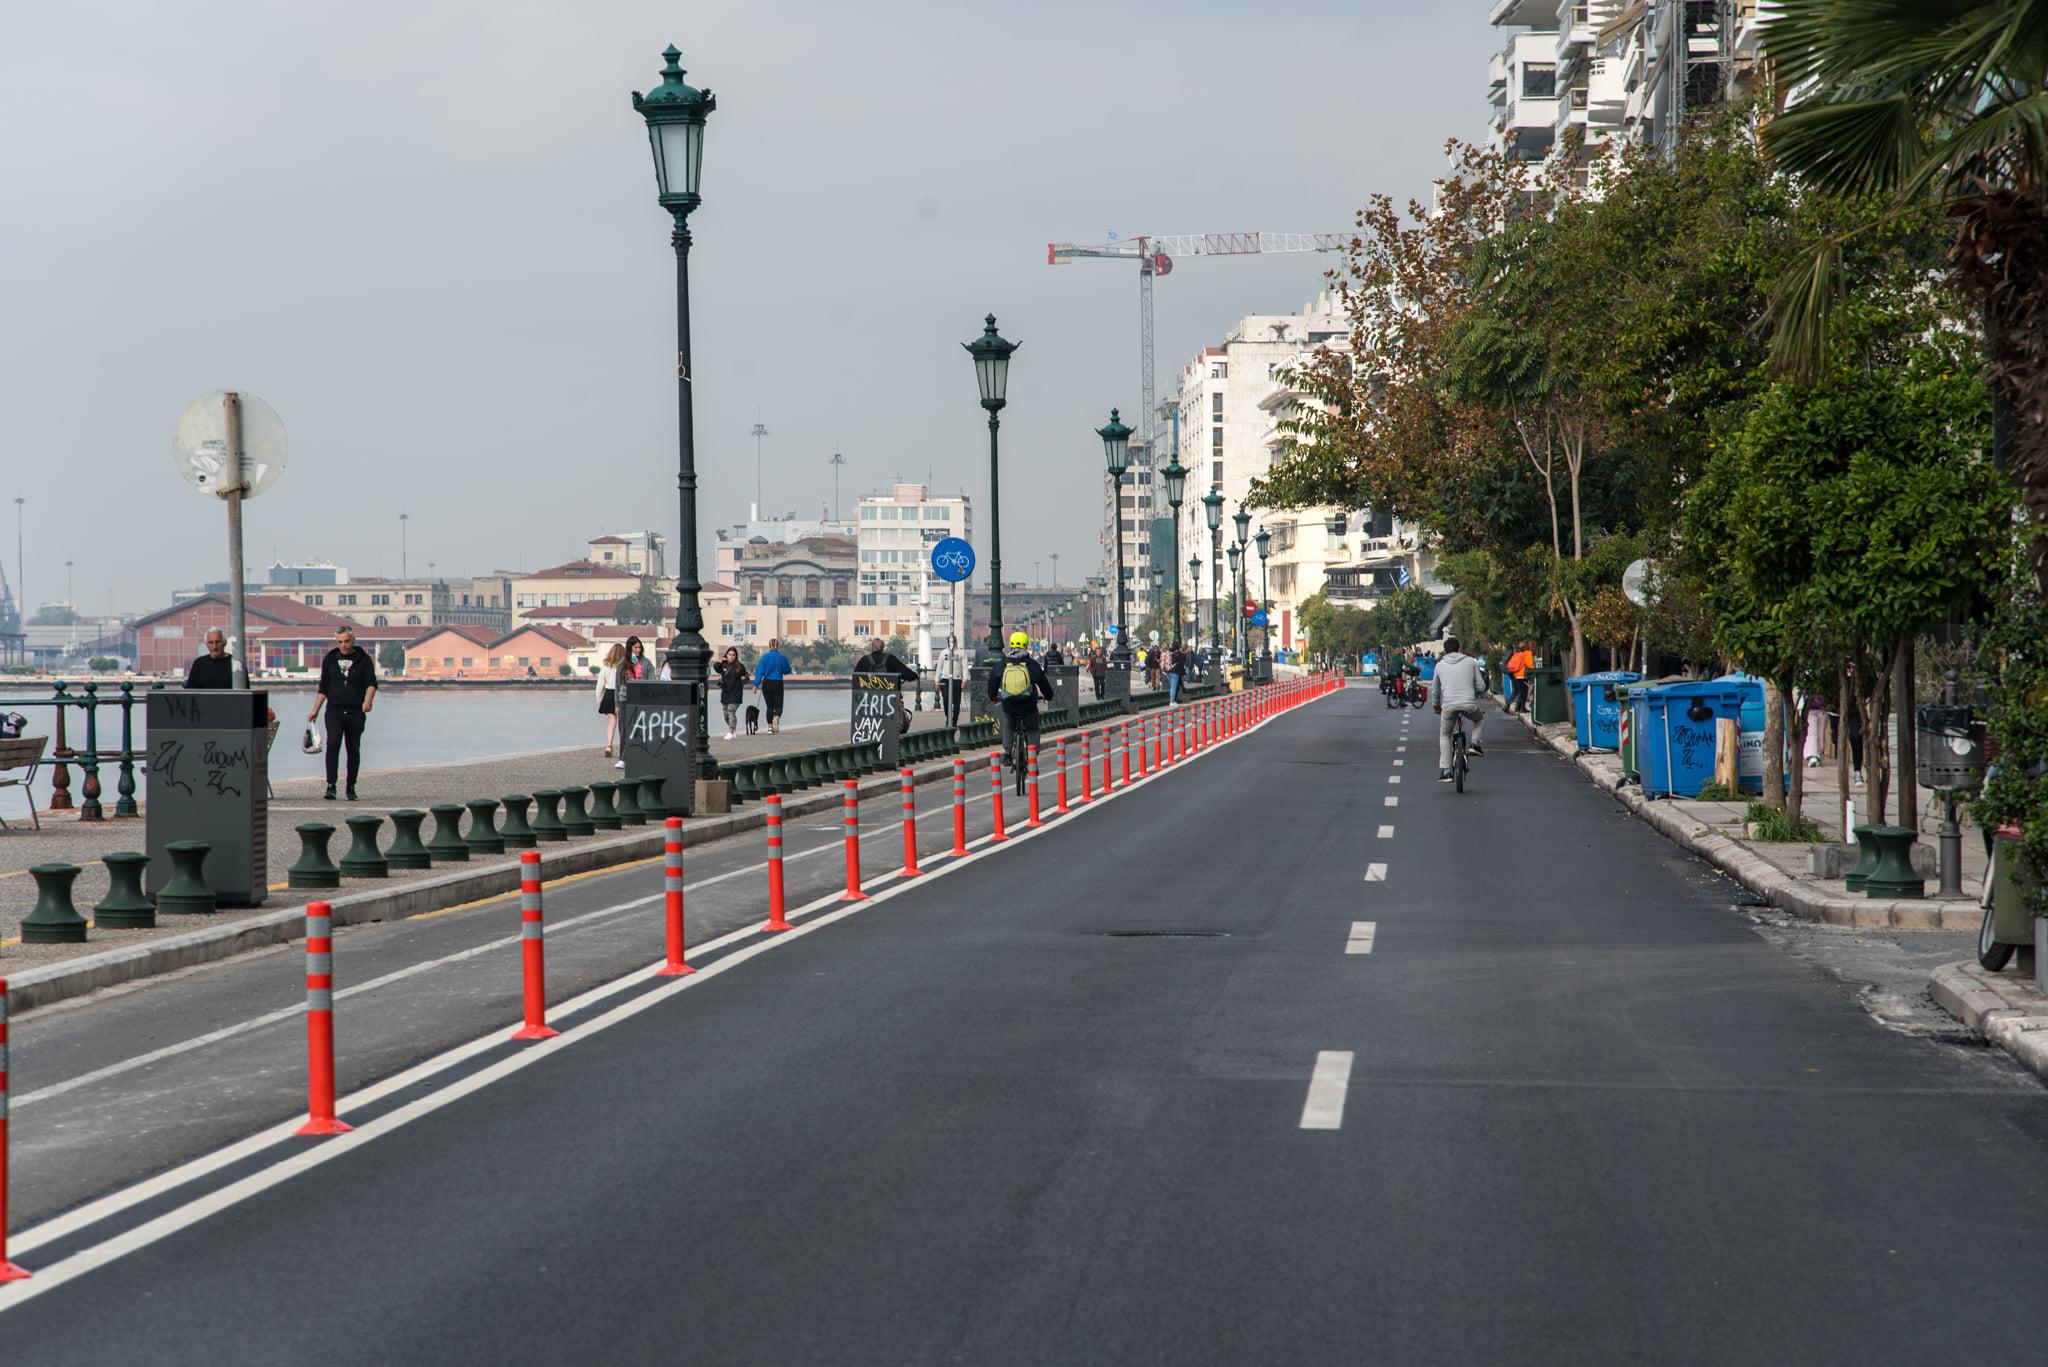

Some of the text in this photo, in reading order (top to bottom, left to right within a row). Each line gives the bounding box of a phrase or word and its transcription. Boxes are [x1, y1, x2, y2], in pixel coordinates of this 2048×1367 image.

[855, 692, 897, 716] ARIS
[629, 710, 688, 746] ΑΡΗΣ
[854, 717, 883, 731] JAN
